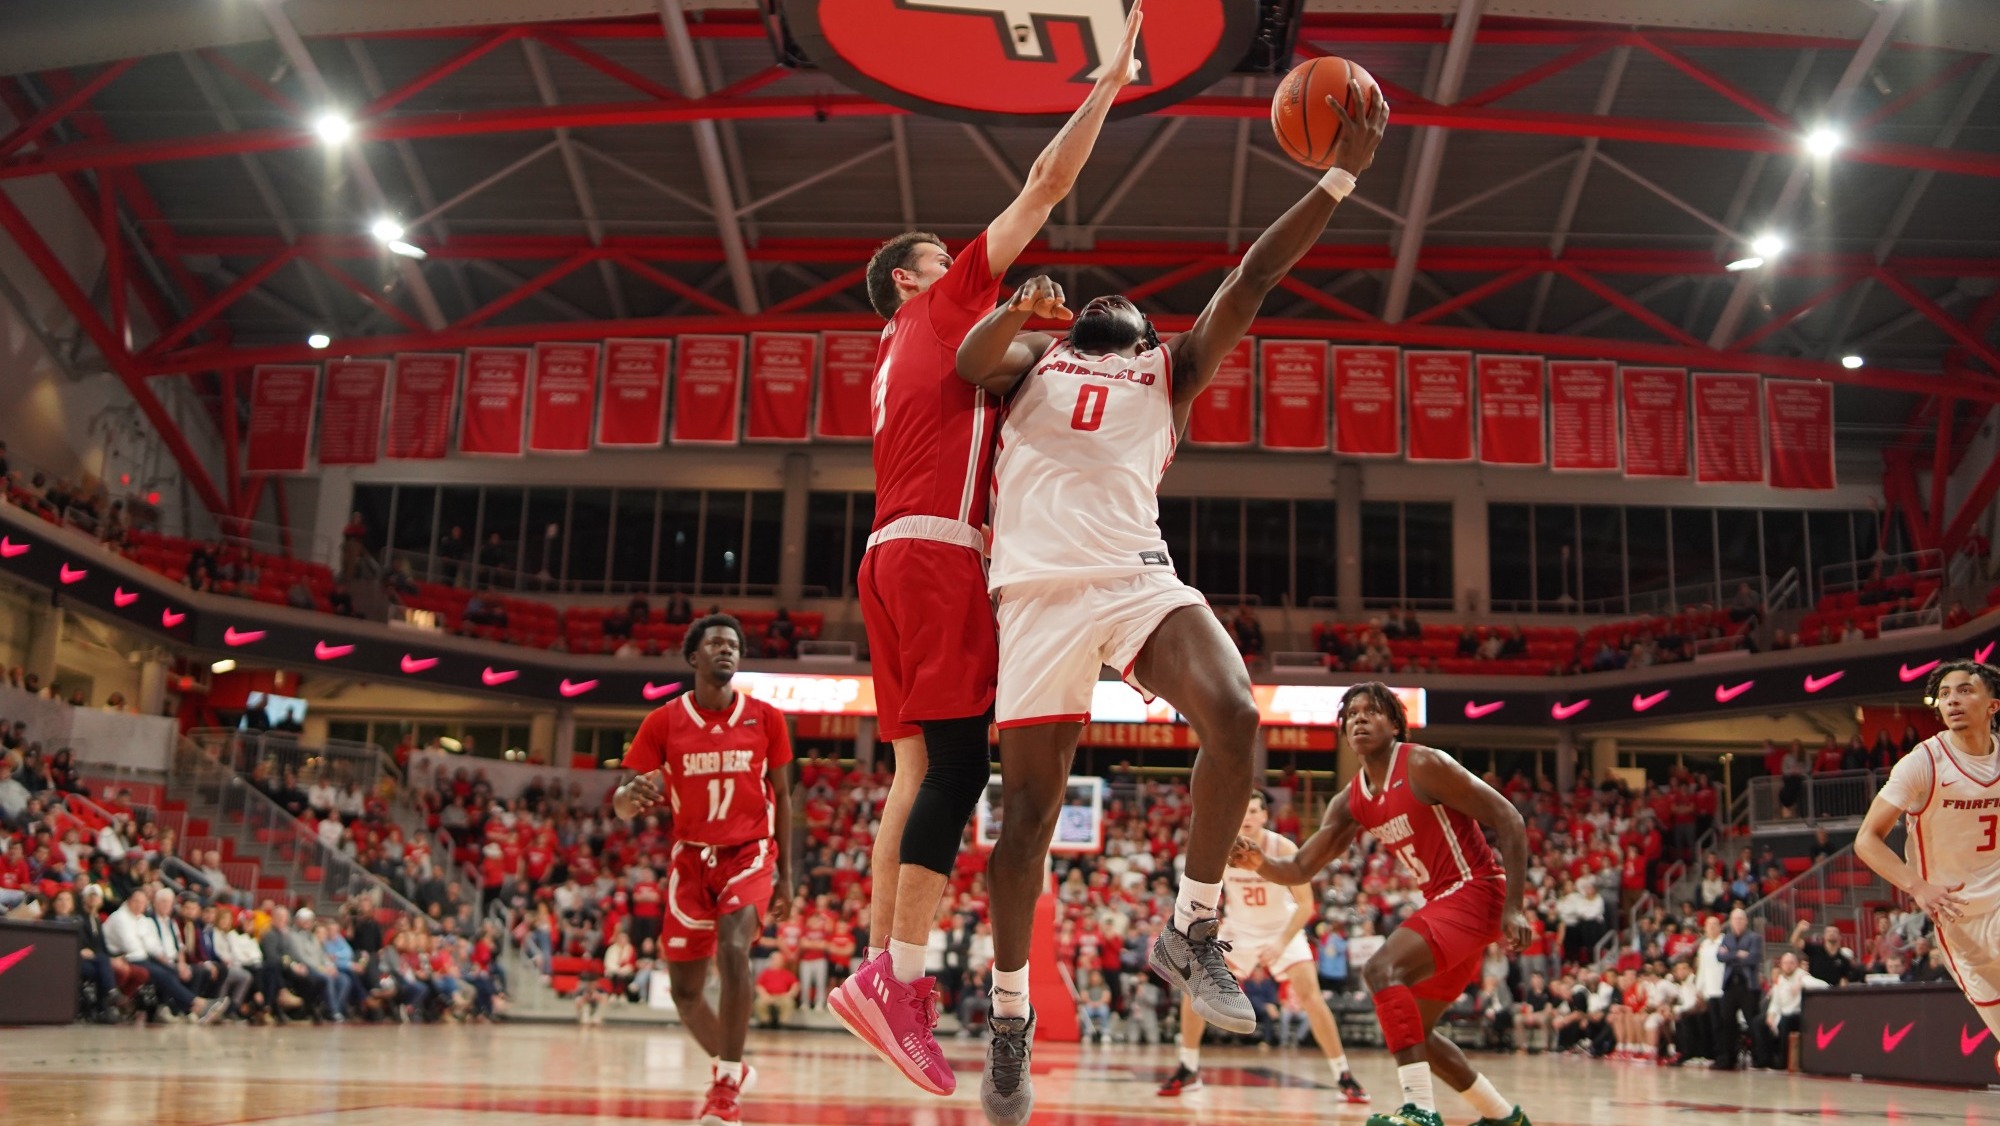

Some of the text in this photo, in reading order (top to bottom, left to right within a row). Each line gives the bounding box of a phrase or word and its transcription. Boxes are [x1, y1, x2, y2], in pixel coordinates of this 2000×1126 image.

[1038, 361, 1156, 386] FAIRELD
[1071, 384, 1109, 431] 0
[1081, 722, 1174, 745] THLETICS
[1269, 728, 1308, 746] AME
[706, 778, 735, 823] 11
[1942, 797, 2000, 810] FAIRFI
[1976, 815, 1998, 852] 3
[1395, 843, 1431, 885] 15
[1243, 886, 1266, 906] 20
